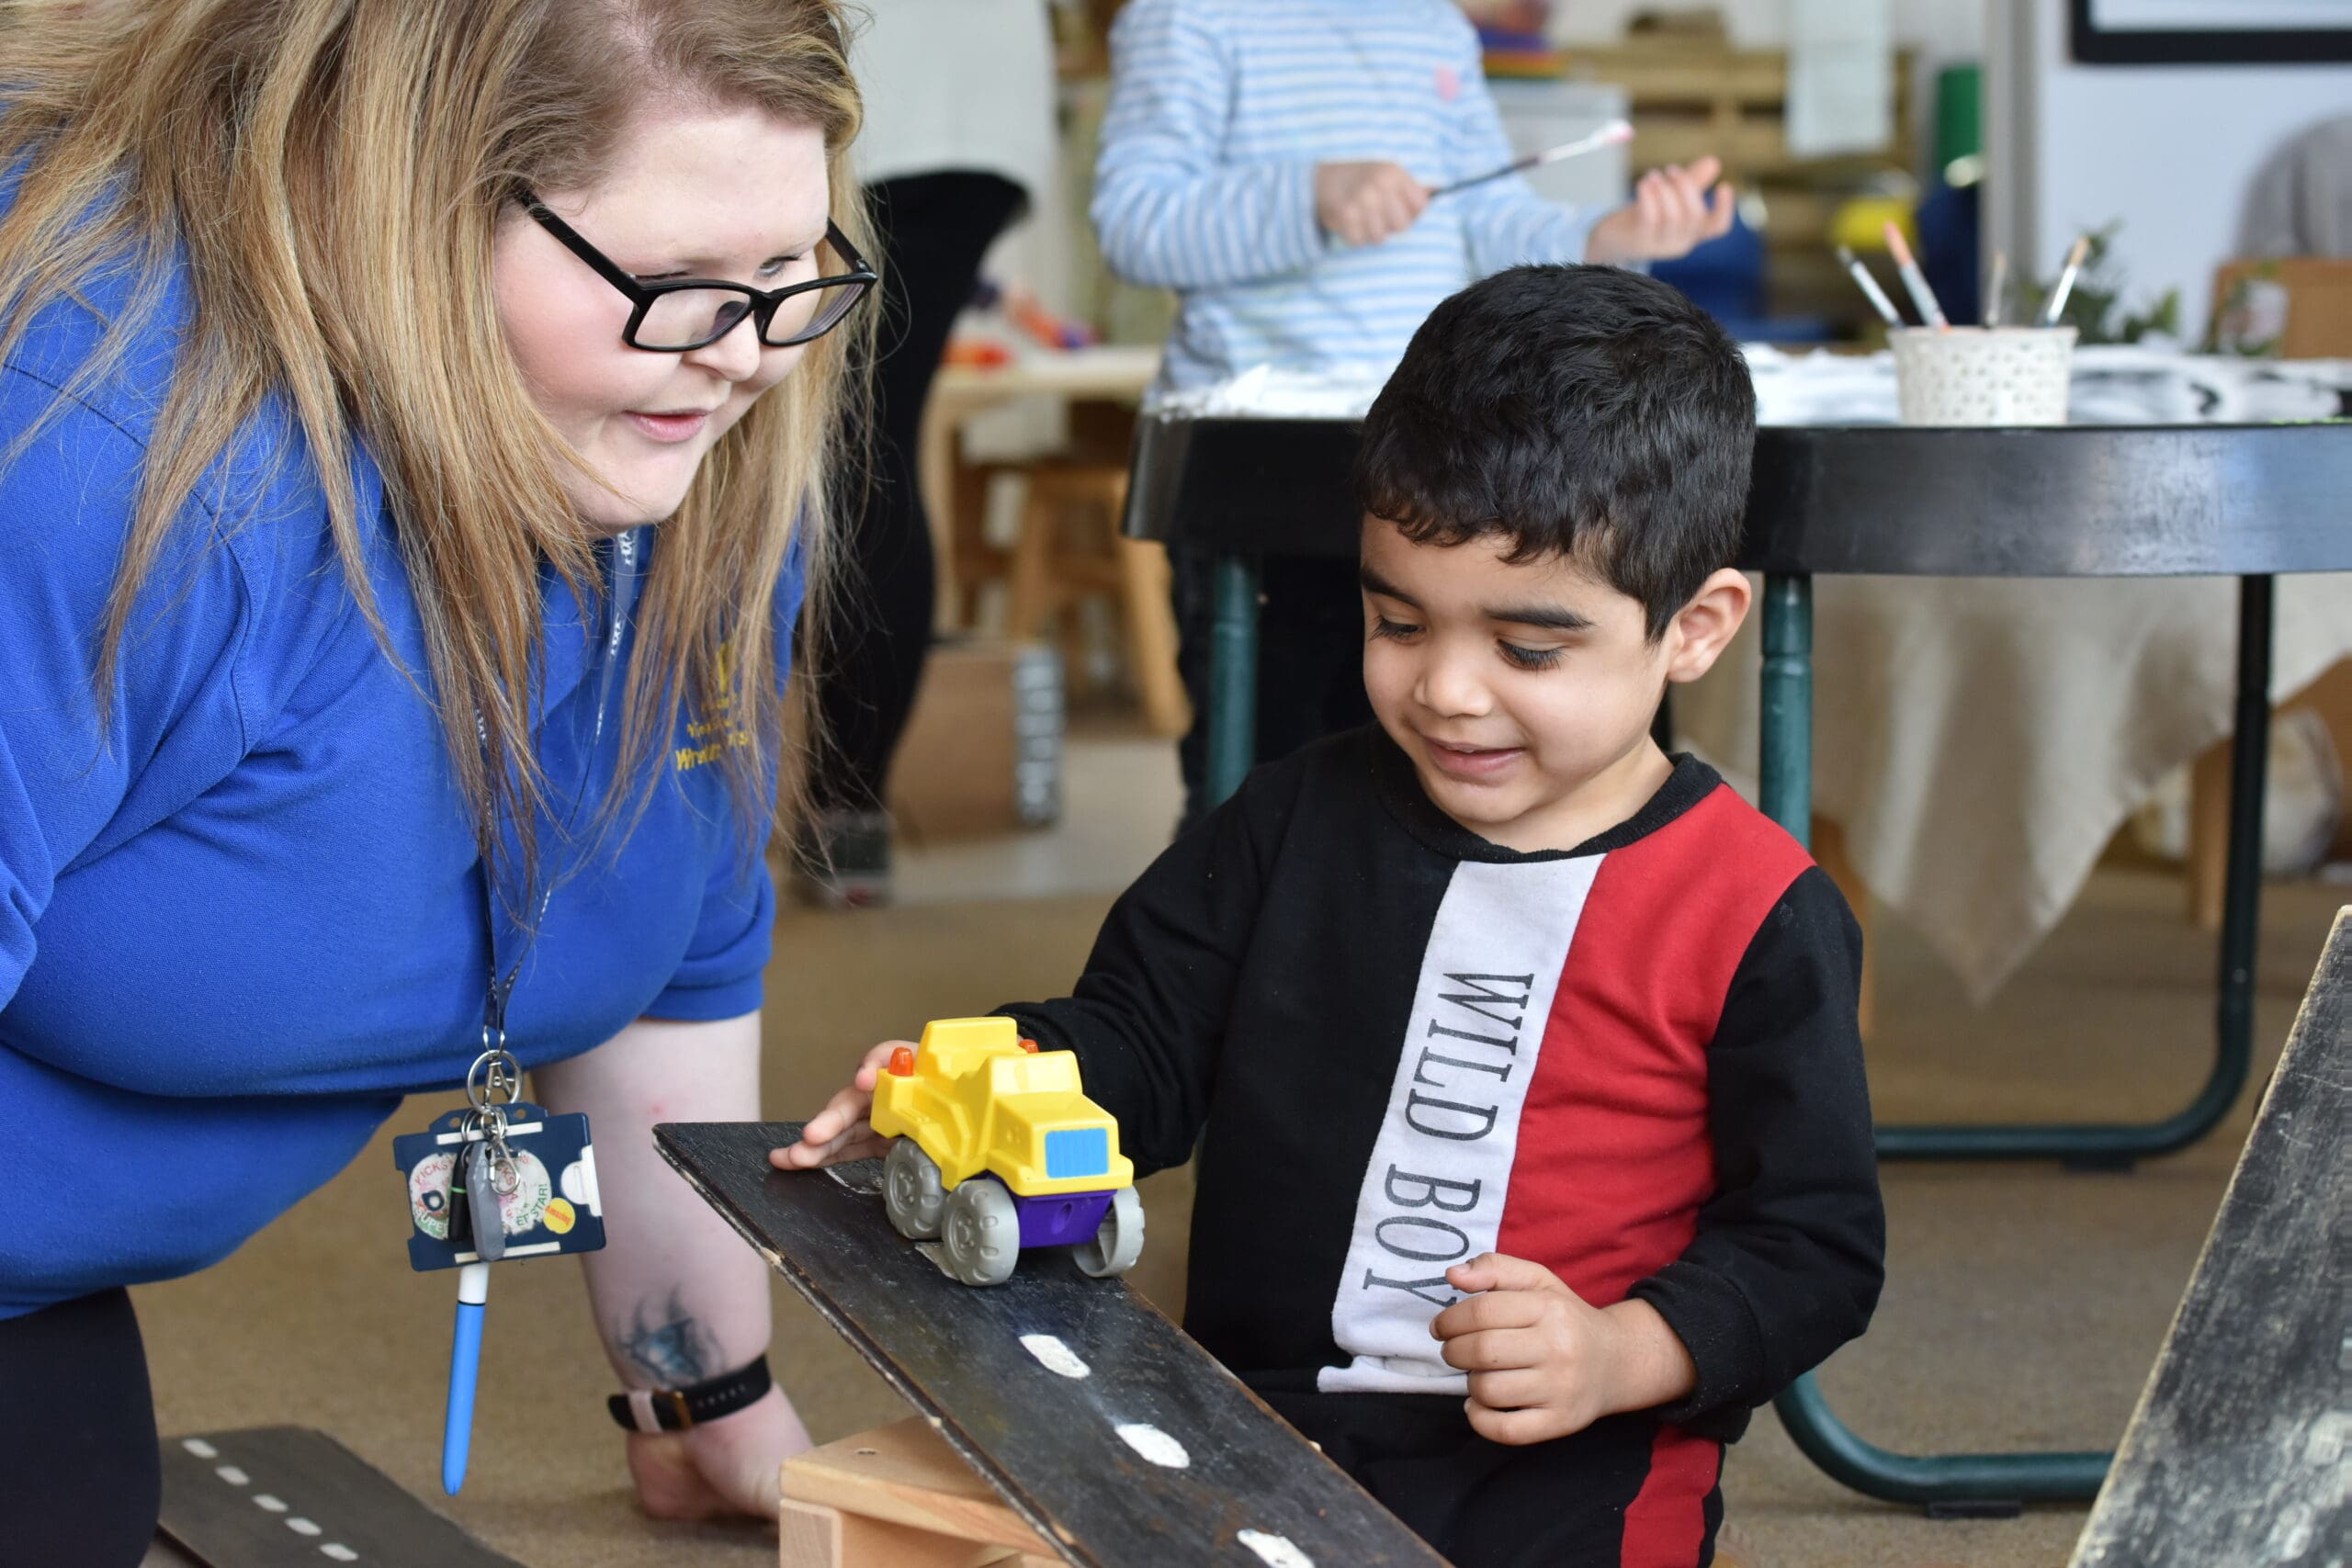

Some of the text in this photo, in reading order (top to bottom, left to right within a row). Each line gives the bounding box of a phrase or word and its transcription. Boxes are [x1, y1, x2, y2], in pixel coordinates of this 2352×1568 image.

[1363, 973, 1535, 1308] WILD BOY
[415, 1158, 454, 1186] KICKS
[414, 1210, 446, 1232] SUPE
